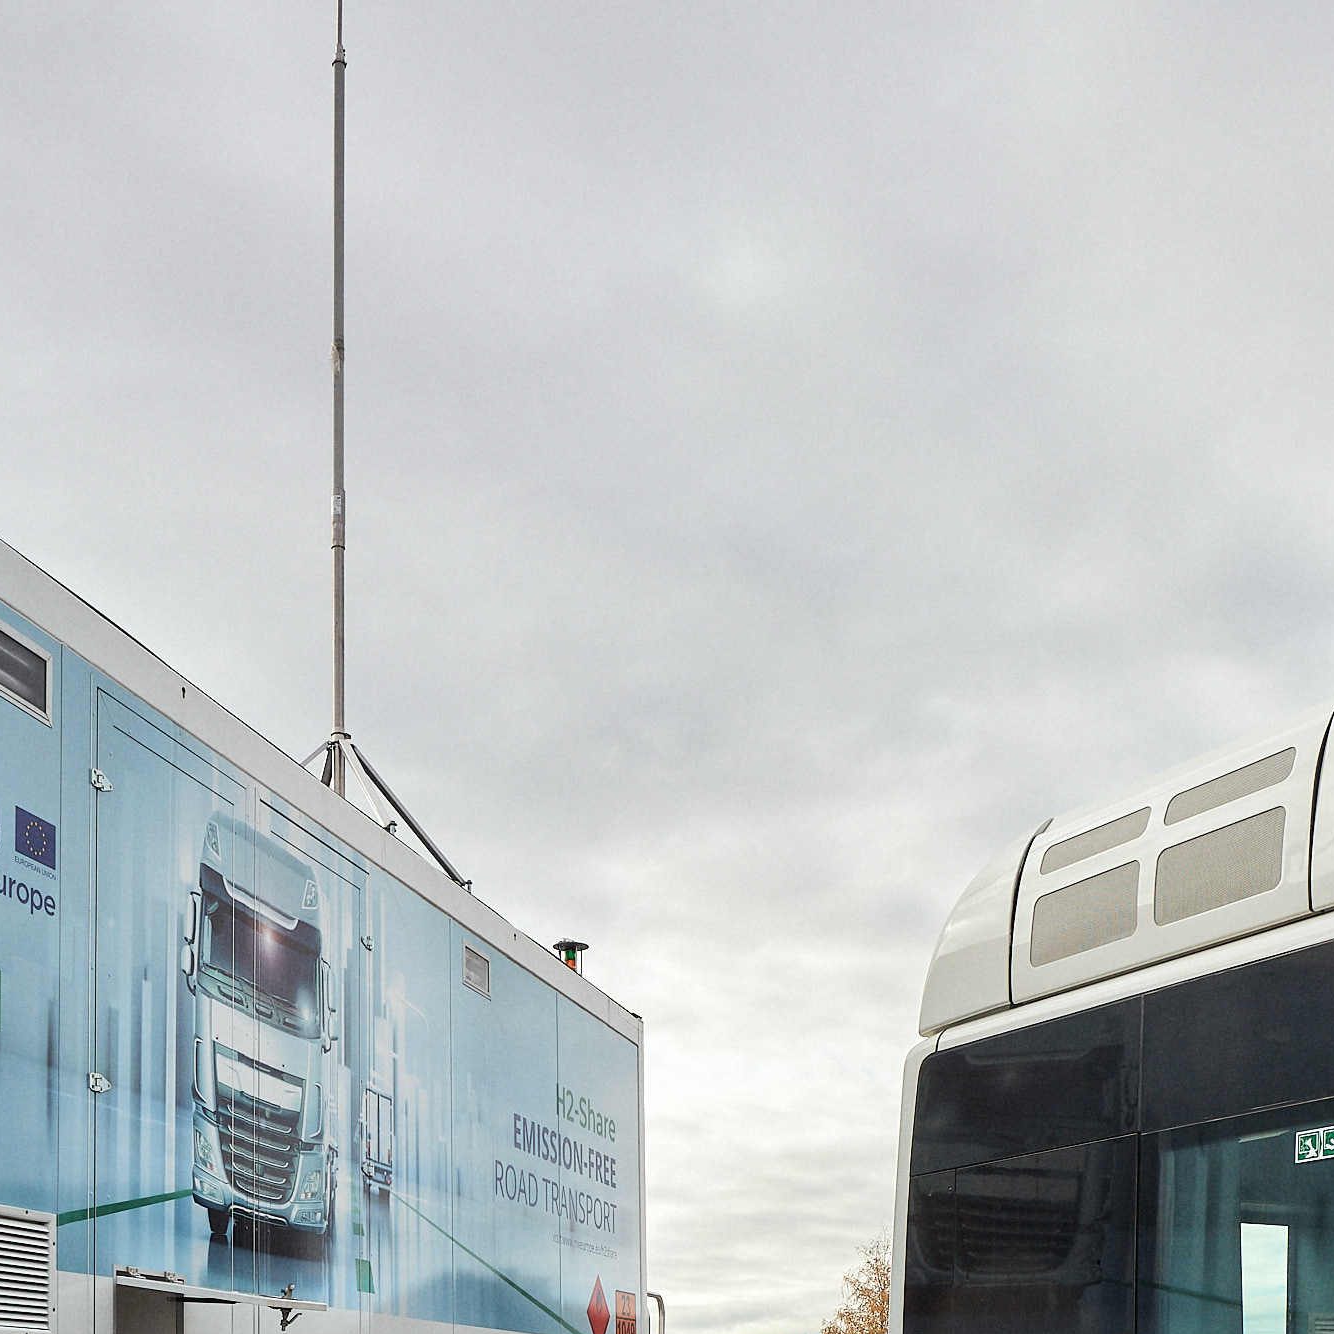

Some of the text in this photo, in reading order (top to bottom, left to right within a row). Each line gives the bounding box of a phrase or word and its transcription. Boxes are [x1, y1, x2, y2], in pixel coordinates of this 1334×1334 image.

[14, 855, 56, 880] EUROPEAN UNION
[556, 1083, 616, 1143] H2-Share
[513, 1113, 617, 1189] EMISSION-FREE
[495, 1159, 617, 1234] ROAD TRANSPORT
[621, 1295, 631, 1317] 23
